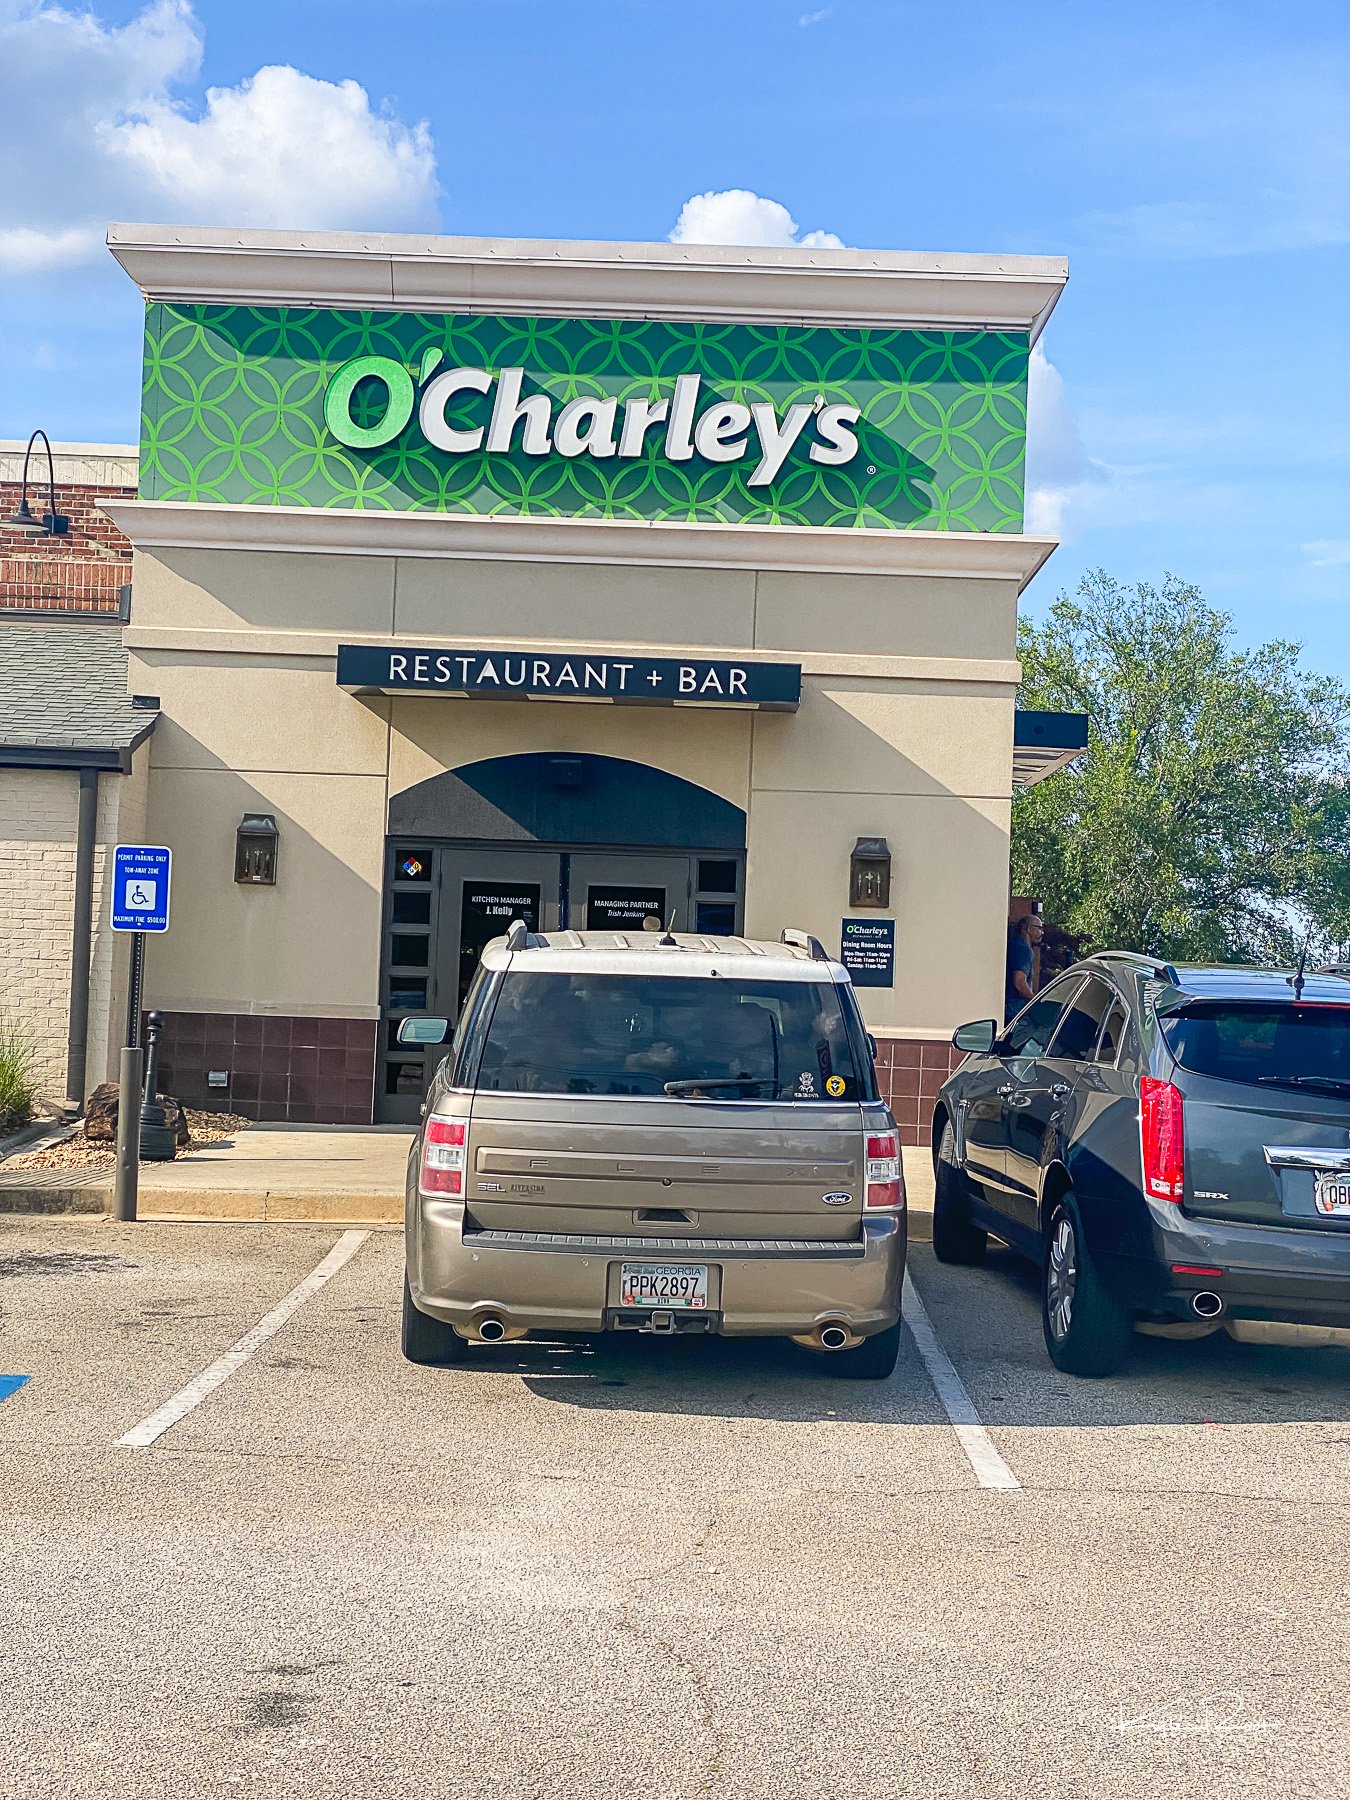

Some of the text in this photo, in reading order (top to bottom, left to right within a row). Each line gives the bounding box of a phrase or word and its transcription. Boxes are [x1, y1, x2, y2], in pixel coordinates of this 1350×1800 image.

[324, 346, 862, 487] O'Charley's
[389, 654, 747, 695] RESTAURANT + BAR
[471, 895, 531, 905] KITCHEN MANAGER
[594, 900, 659, 909] MANAGING PARTNER
[485, 906, 492, 915] J.
[493, 906, 513, 916] Kelly
[607, 909, 646, 918] Trish Jenkins
[842, 941, 860, 949] Dining
[477, 1182, 507, 1192] SEL
[1193, 1190, 1230, 1200] SRX
[1330, 1186, 1350, 1205] QB
[655, 1266, 701, 1276] GEORGIA
[630, 1275, 699, 1298] PPK2897
